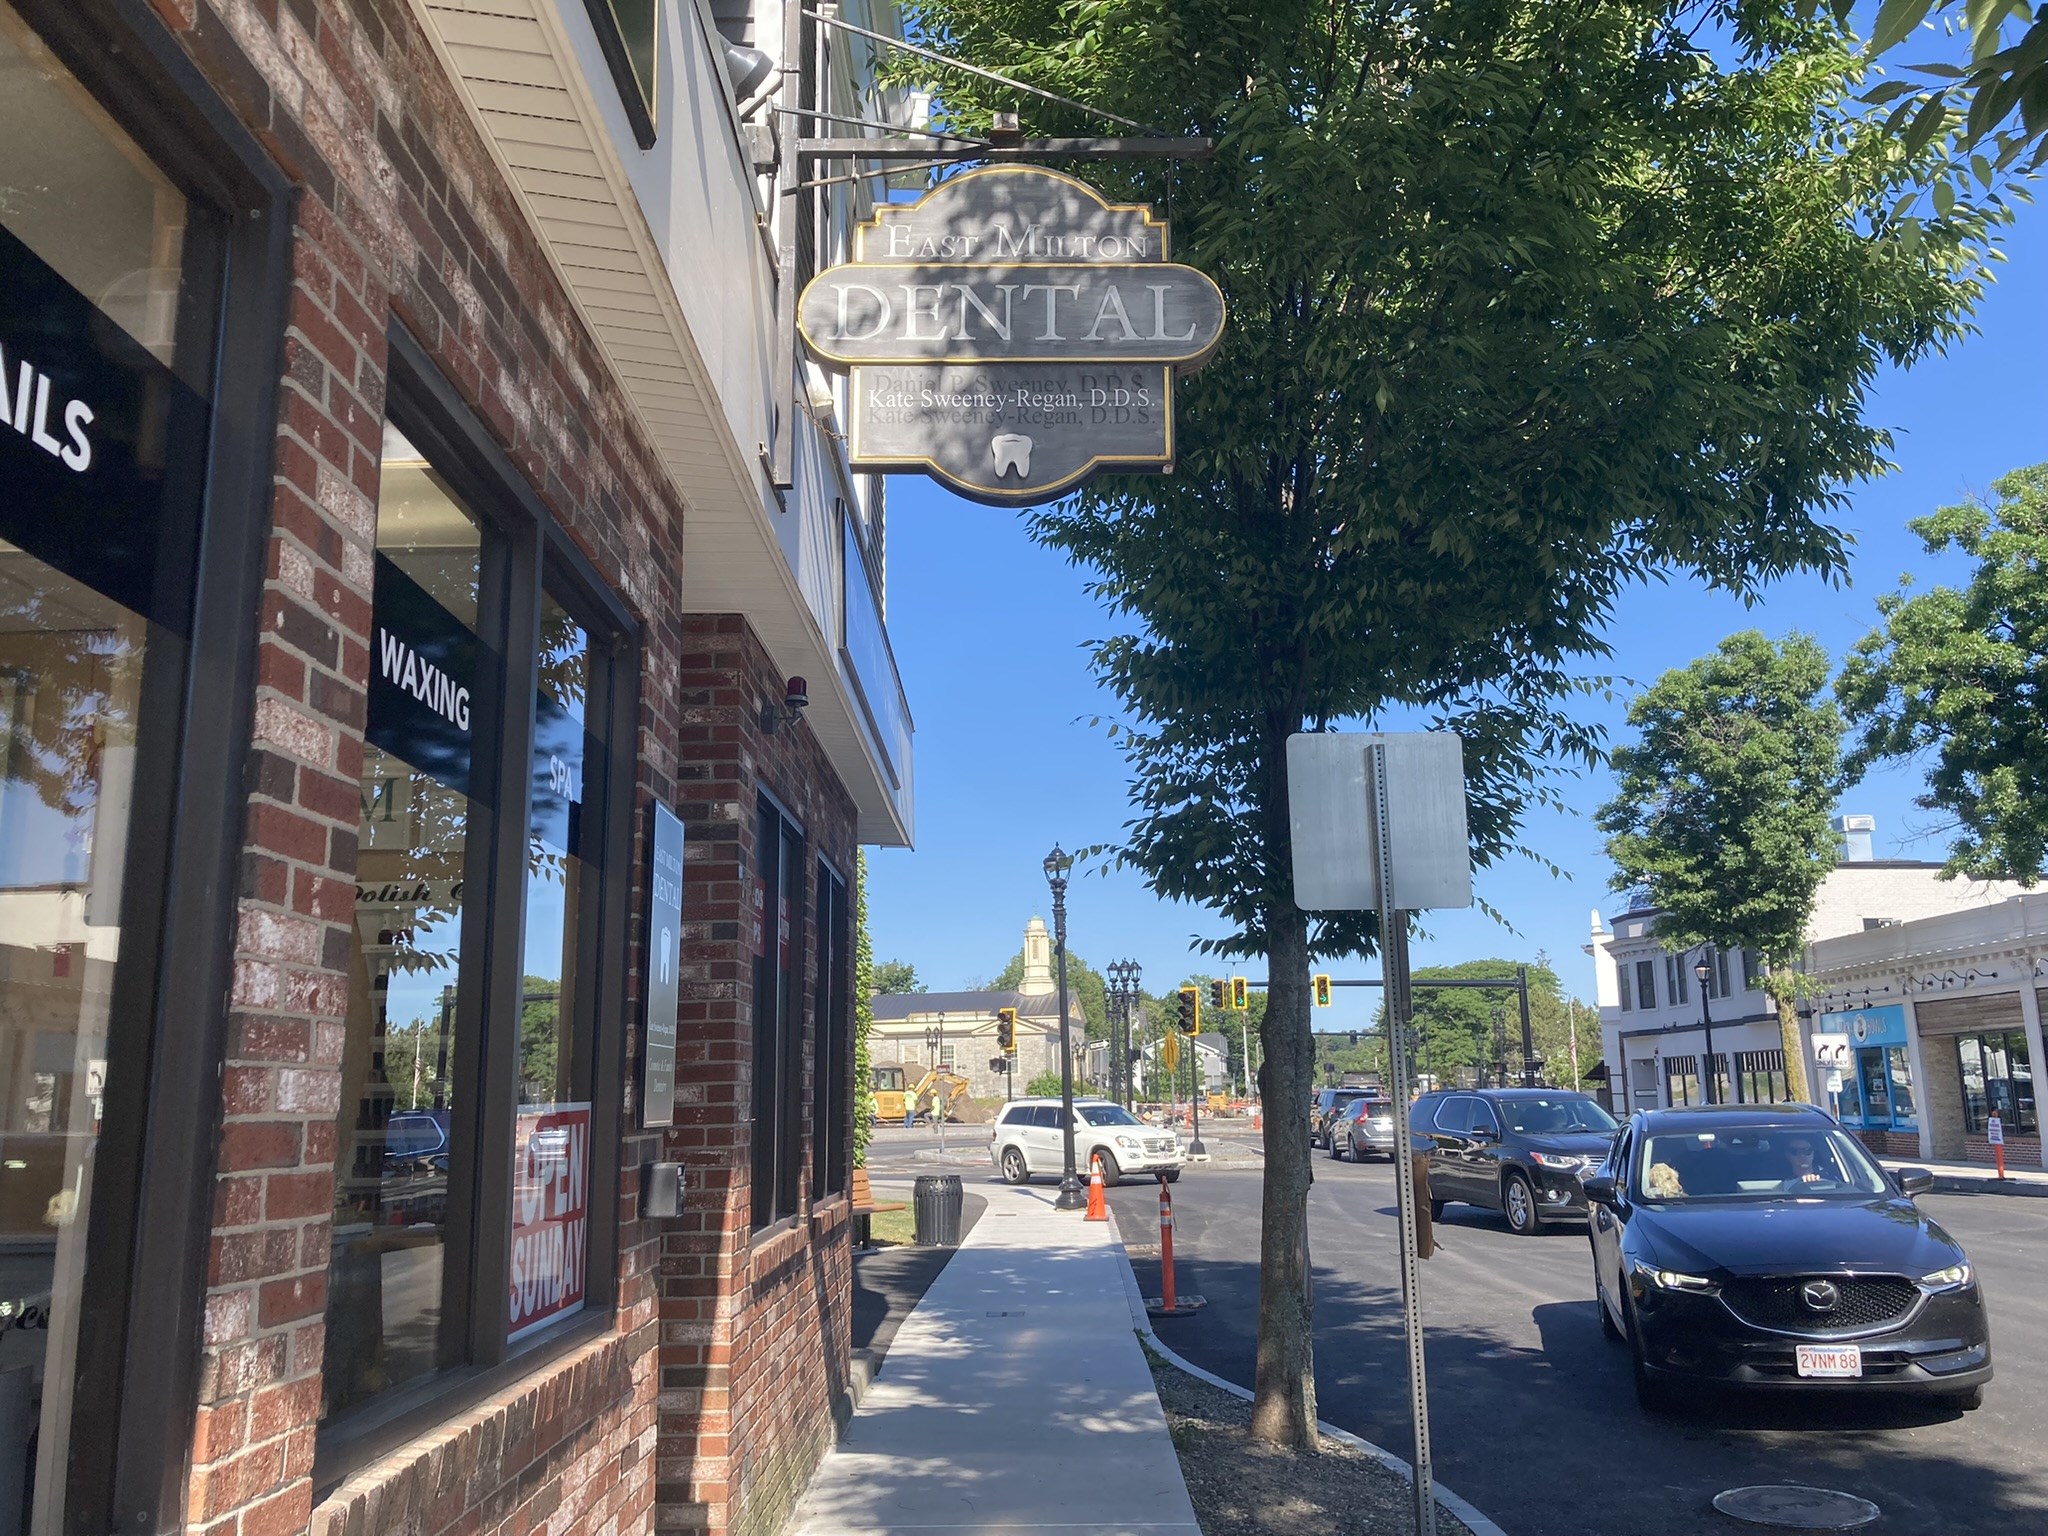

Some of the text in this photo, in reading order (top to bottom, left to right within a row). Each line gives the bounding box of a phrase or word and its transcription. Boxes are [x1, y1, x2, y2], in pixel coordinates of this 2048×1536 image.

[827, 284, 1197, 341] DENTAL
[868, 388, 1155, 412] Kate Sweeney-Regan, D.D.S.
[379, 627, 470, 731] WAXING
[549, 754, 574, 801] SPA
[654, 873, 680, 911] DENTAL
[521, 1122, 584, 1226] OPEN
[510, 1217, 584, 1324] SUNDAY
[1800, 1353, 1857, 1369] 2VNM 88
